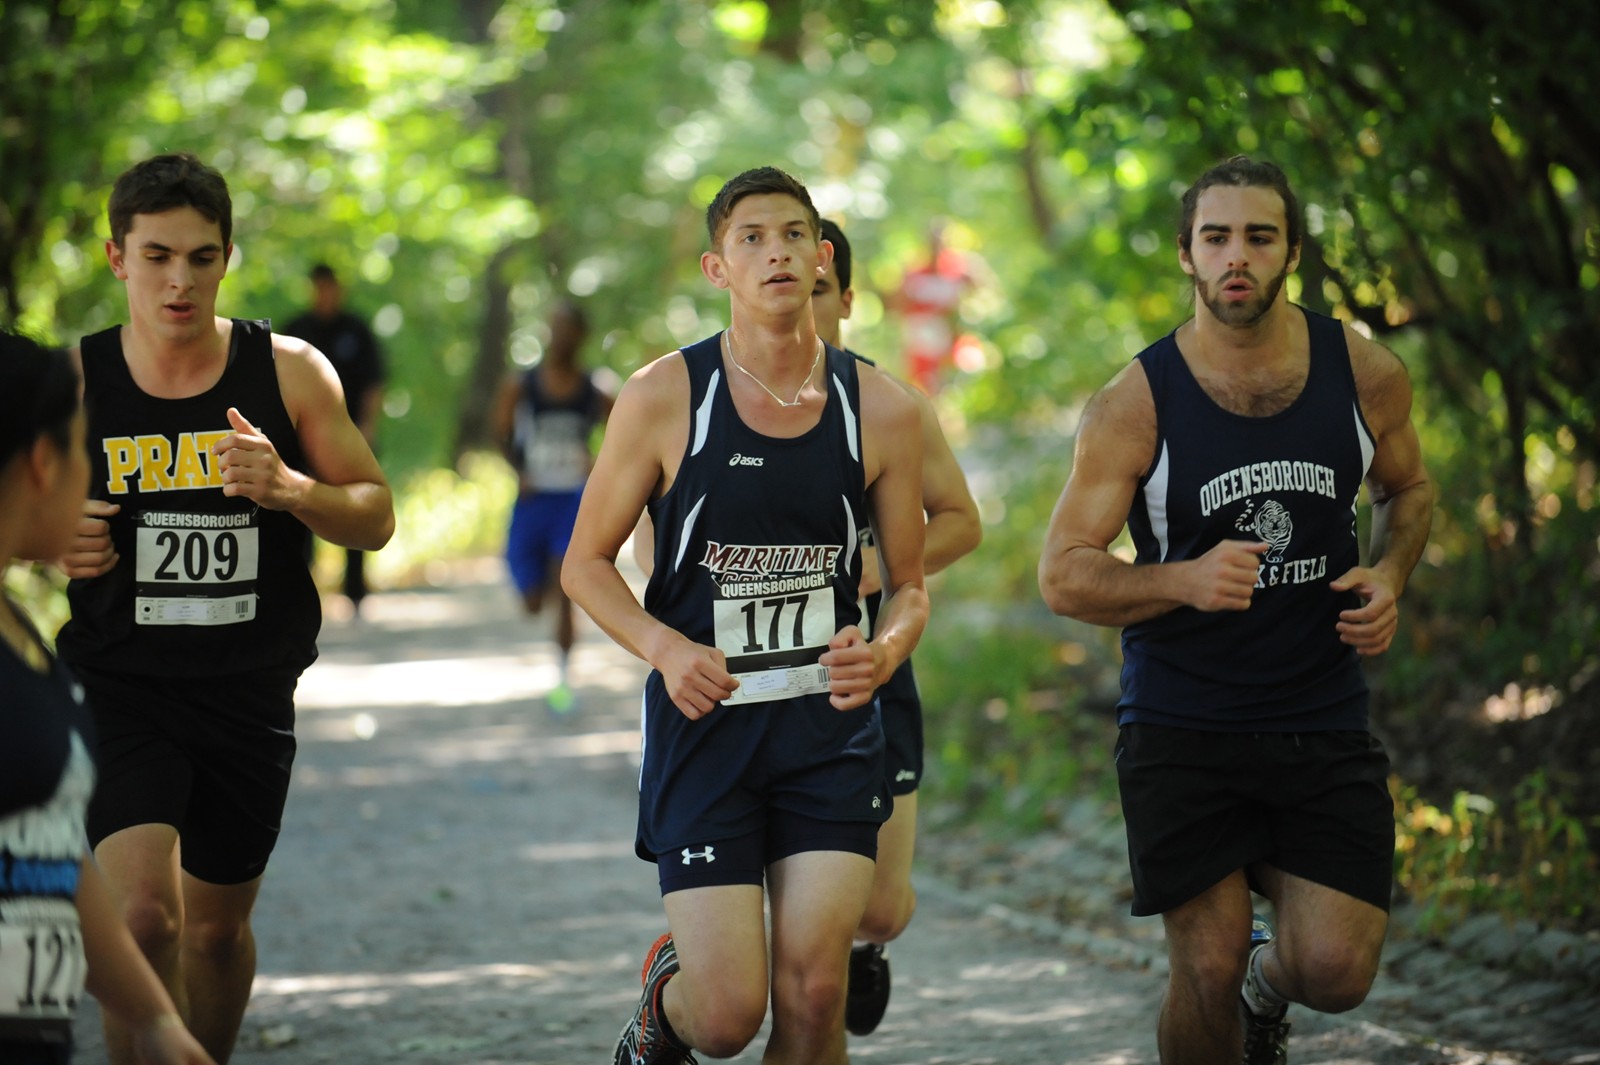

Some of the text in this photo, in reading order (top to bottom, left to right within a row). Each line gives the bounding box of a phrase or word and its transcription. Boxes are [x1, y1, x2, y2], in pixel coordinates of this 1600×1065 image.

[102, 428, 262, 494] PRAT
[1200, 461, 1336, 517] QUEENSBOROUGH
[143, 511, 250, 528] QUEENSBOROUGH
[154, 530, 239, 581] 209
[698, 540, 843, 576] MARITIME
[1281, 554, 1327, 585] FIELD
[720, 572, 826, 598] QUEENSBOROUGH
[741, 593, 810, 653] 177
